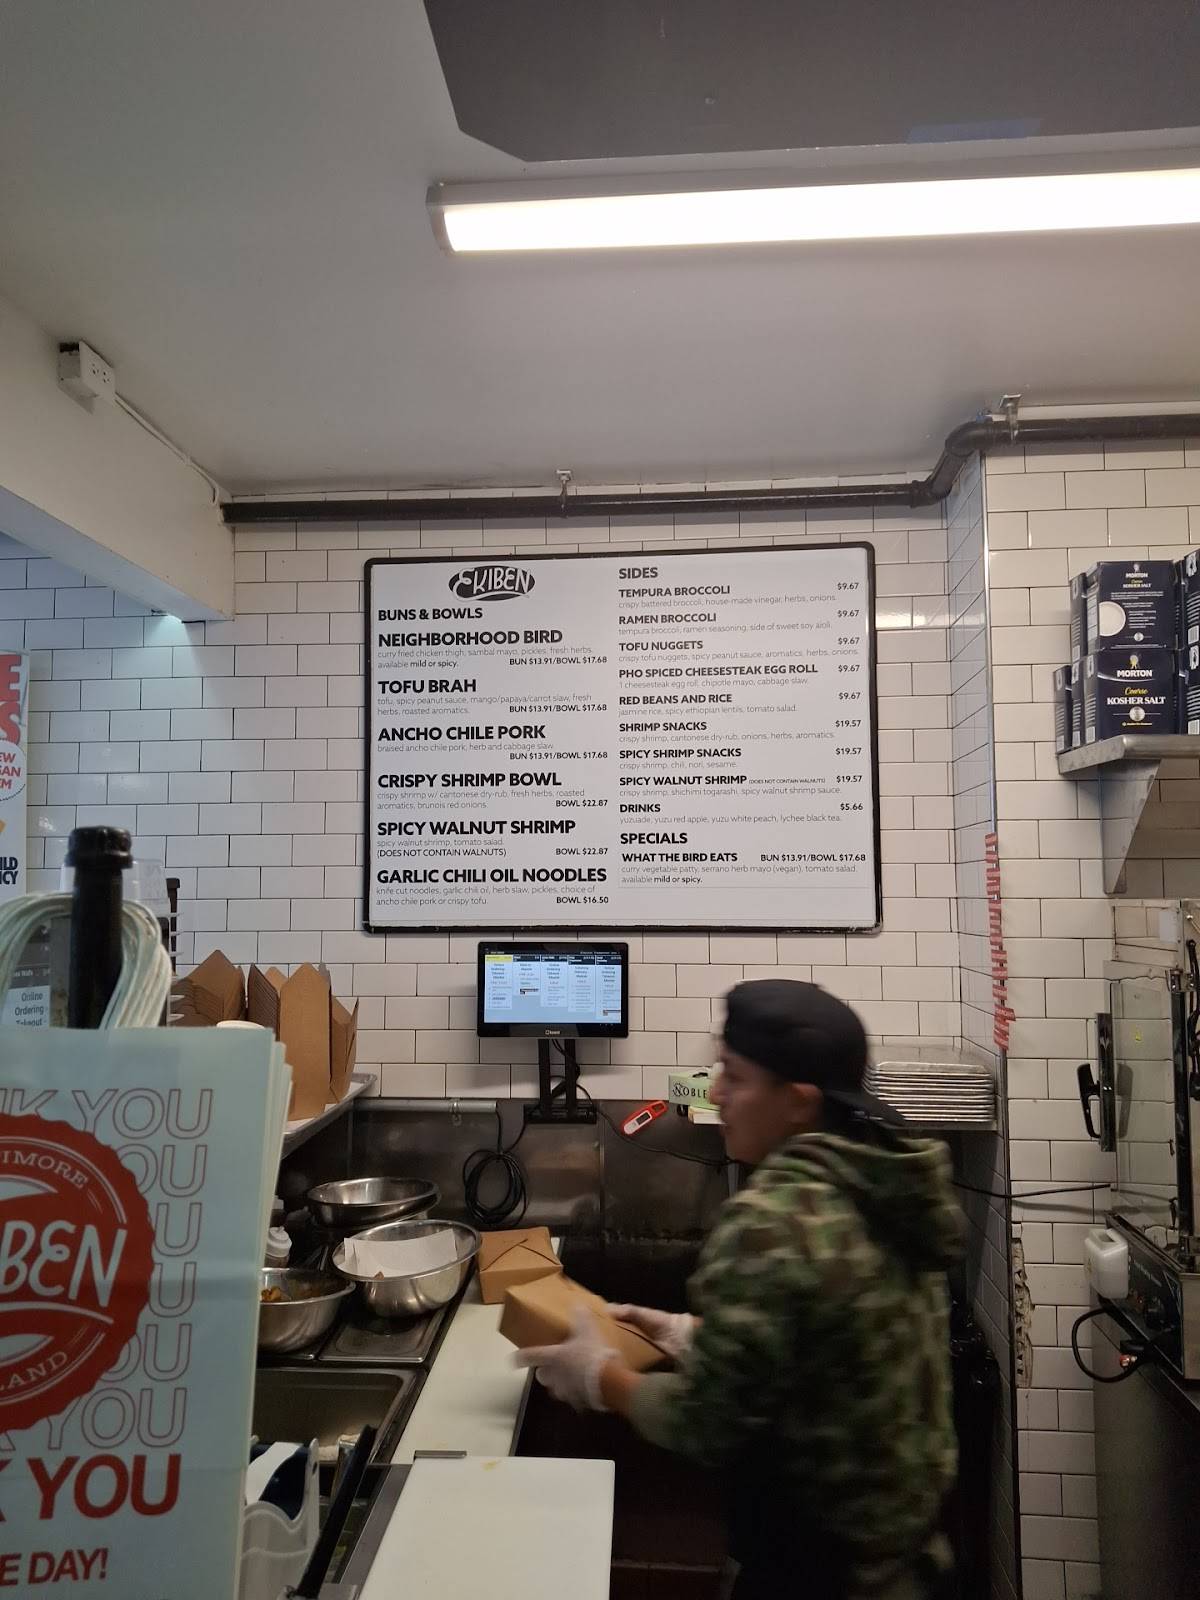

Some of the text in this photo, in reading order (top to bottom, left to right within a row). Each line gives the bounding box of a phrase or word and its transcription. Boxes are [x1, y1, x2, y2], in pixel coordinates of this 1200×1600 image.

[618, 567, 658, 579] SIDES
[453, 566, 531, 600] EKIBEN
[837, 581, 859, 590] $9.67
[619, 585, 730, 597] TEMPURA BROCCOLI
[378, 607, 483, 620] BUNS & BOWLS
[618, 612, 716, 624] RAMEN BROCCOLI
[837, 609, 859, 617] $9.67
[378, 629, 562, 647] NEIGHBORHOOD BIRD
[837, 636, 859, 645] $9.67
[619, 640, 703, 651] TOFU NUGGETS
[409, 659, 427, 667] mild
[528, 656, 580, 665] $13.91/BOWL
[618, 664, 817, 678] PHO SPICED CHEESESTEAK EGG ROLL
[838, 664, 860, 672] $9.67
[1117, 670, 1153, 678] MORTON
[379, 679, 476, 694] TOFU BRAH
[619, 693, 732, 705] RED BEANS AND RICE
[838, 691, 860, 700] $9.67
[1107, 696, 1166, 705] KOSHER SALT
[528, 704, 580, 712] $13.91/BOWL
[581, 703, 607, 711] $17.68
[619, 721, 707, 731] SHRIMP SNACKS
[835, 719, 861, 727] $19.57
[378, 725, 545, 741] ANCHO CHILE PORK
[509, 751, 608, 760] BUN $13.91/BOWL $17.68
[619, 748, 741, 758] SPICY SHRIMP SNACKS
[835, 747, 862, 755] $19.57
[377, 772, 561, 788] CRISPY SHRIMP BOWL
[619, 775, 747, 785] SPICY WALNUT SHRIMP
[555, 799, 608, 807] BOWL $22.87
[619, 803, 661, 812] DRINKS
[840, 802, 863, 810] $5.66
[377, 820, 575, 835] SPICY WALNUT SHRIMP
[620, 832, 688, 844] SPECIALS
[376, 849, 402, 857] (DOES
[422, 848, 461, 856] CONTAIN
[461, 848, 506, 856] WALNUTS)
[555, 847, 608, 855] BOWL $22.87
[621, 852, 738, 862] WHAT THE BIRD EATS
[838, 853, 866, 861] $17.68
[377, 868, 607, 883] GARLIC CHILI OIL NOODLES
[653, 875, 671, 883] mild
[21, 992, 43, 1001] Online
[15, 1005, 44, 1016] Ordering
[673, 1083, 708, 1098] NOBLE
[72, 1087, 213, 1140] YOU
[114, 1144, 208, 1198] OU
[0, 1351, 67, 1391] AND
[47, 1387, 188, 1450] YOU
[26, 1453, 182, 1521] YOU
[28, 1547, 108, 1585] DAY!
